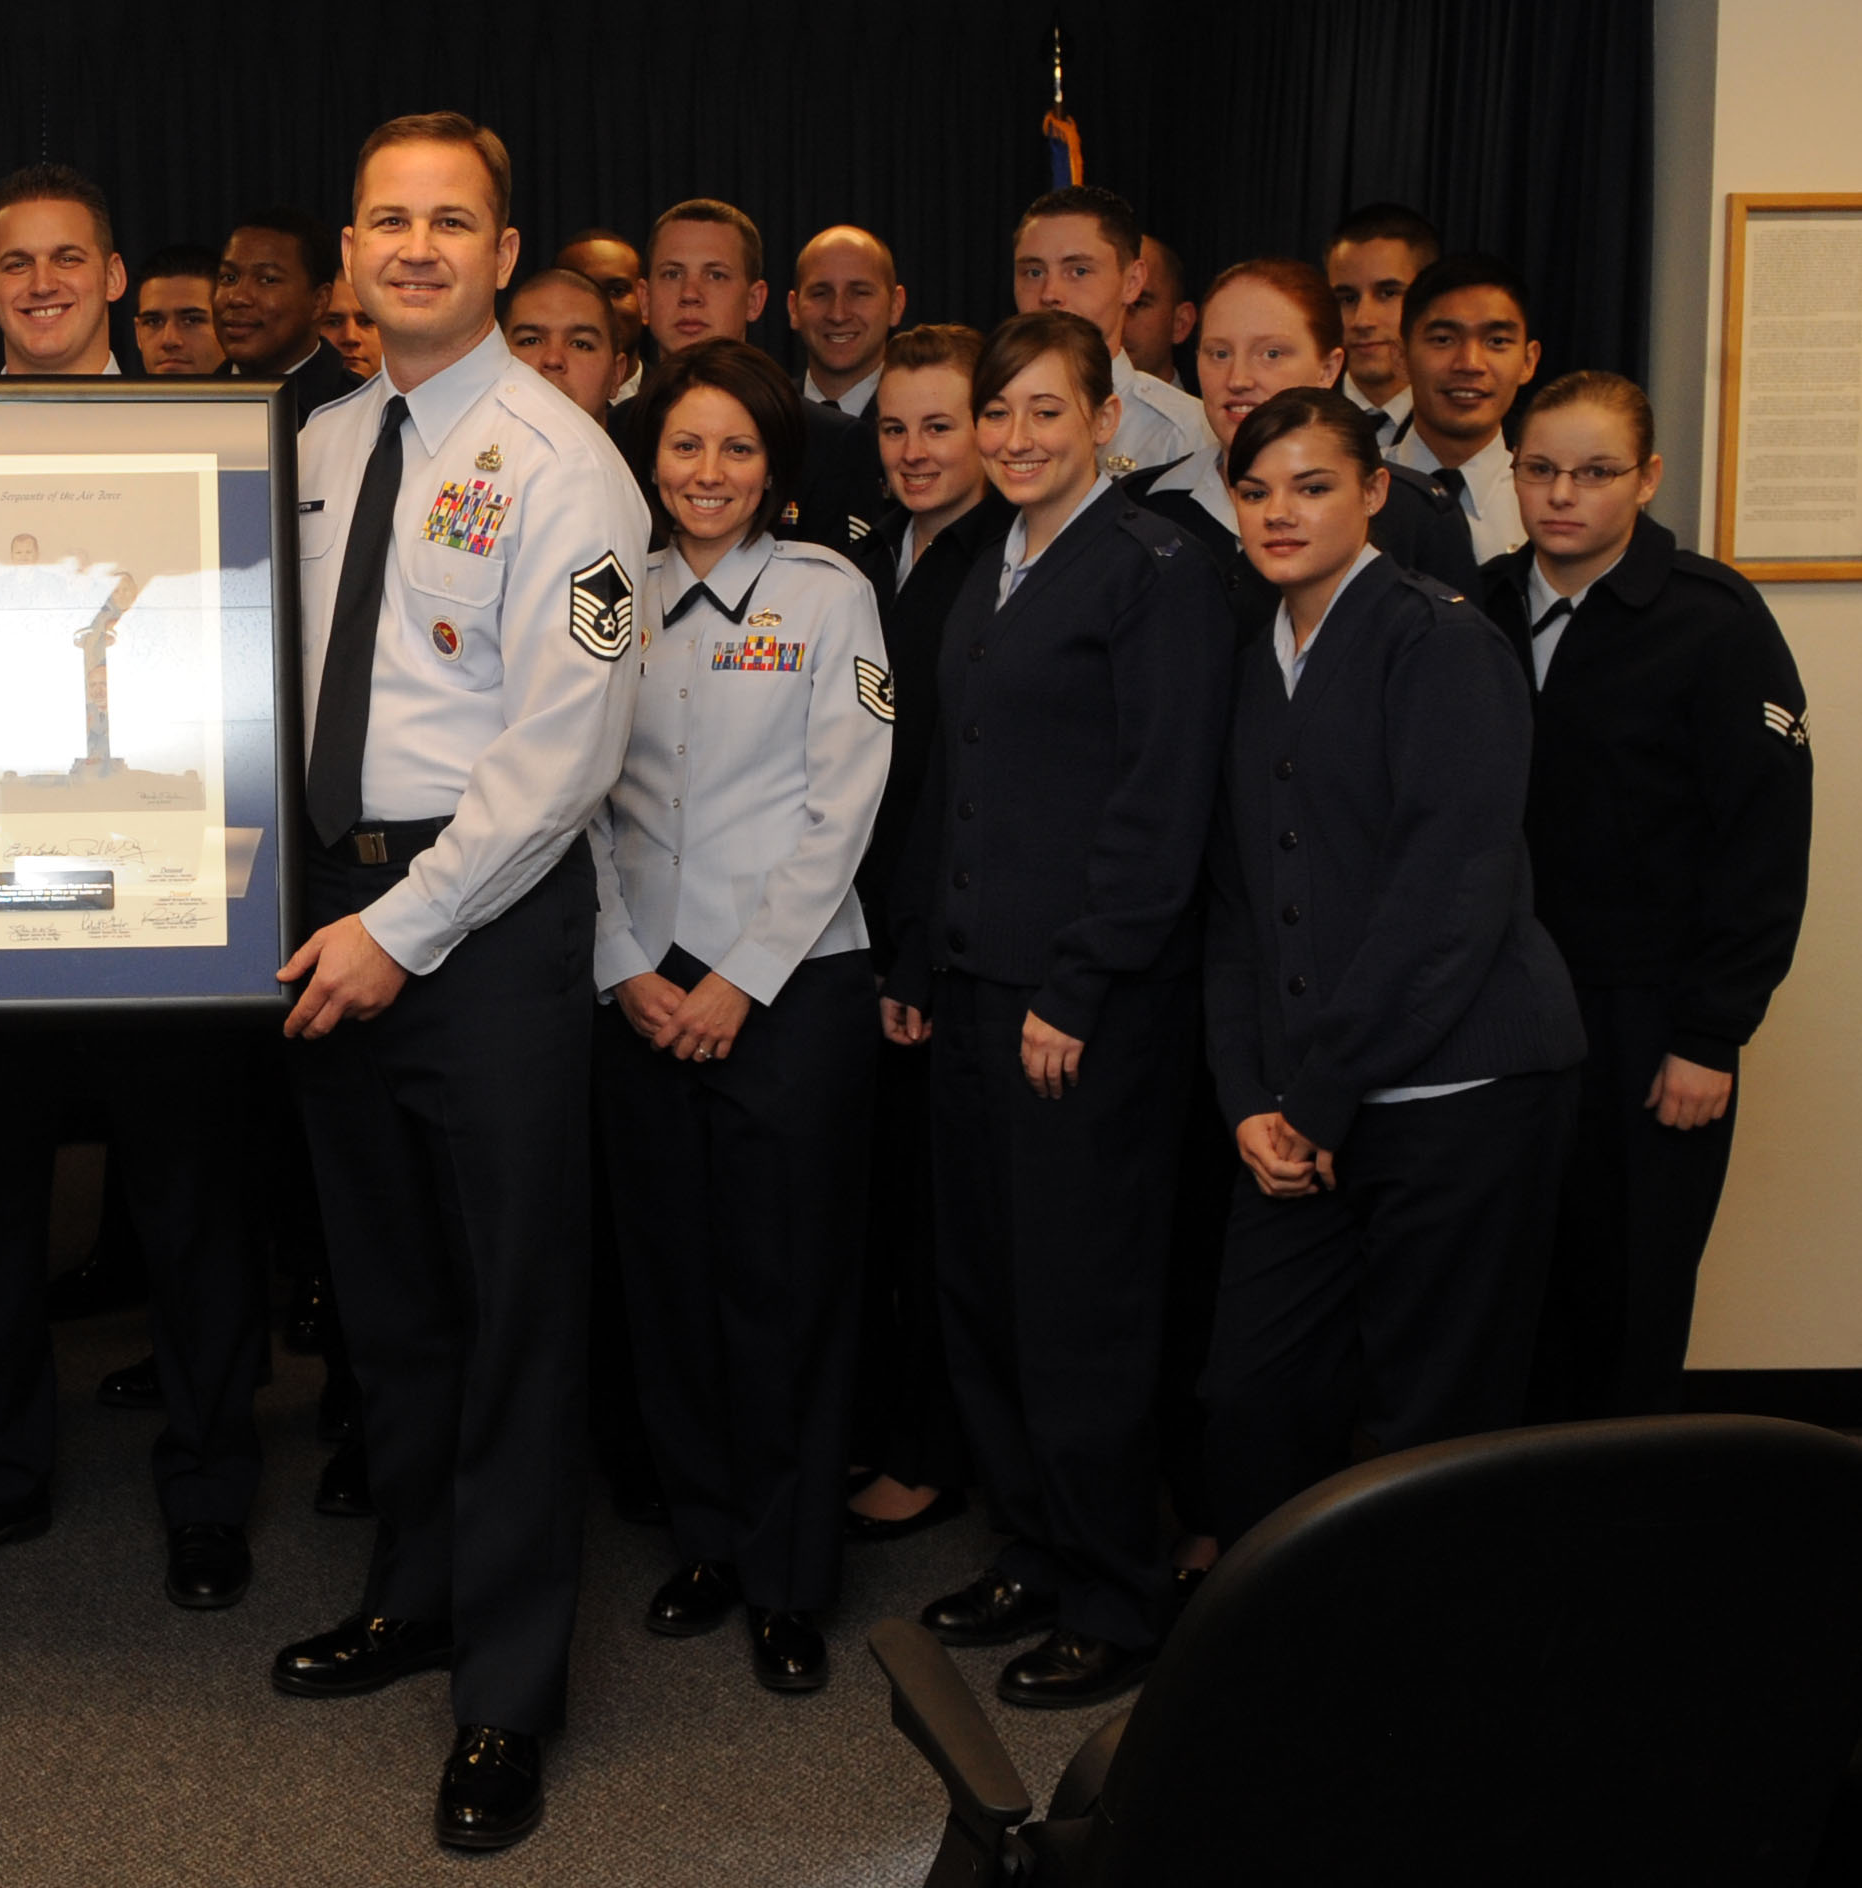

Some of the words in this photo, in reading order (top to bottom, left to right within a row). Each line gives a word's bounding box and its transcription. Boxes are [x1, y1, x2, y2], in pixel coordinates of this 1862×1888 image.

[1, 491, 44, 503] Sergeants
[47, 490, 58, 502] of
[60, 490, 75, 501] the
[76, 489, 94, 501] Air
